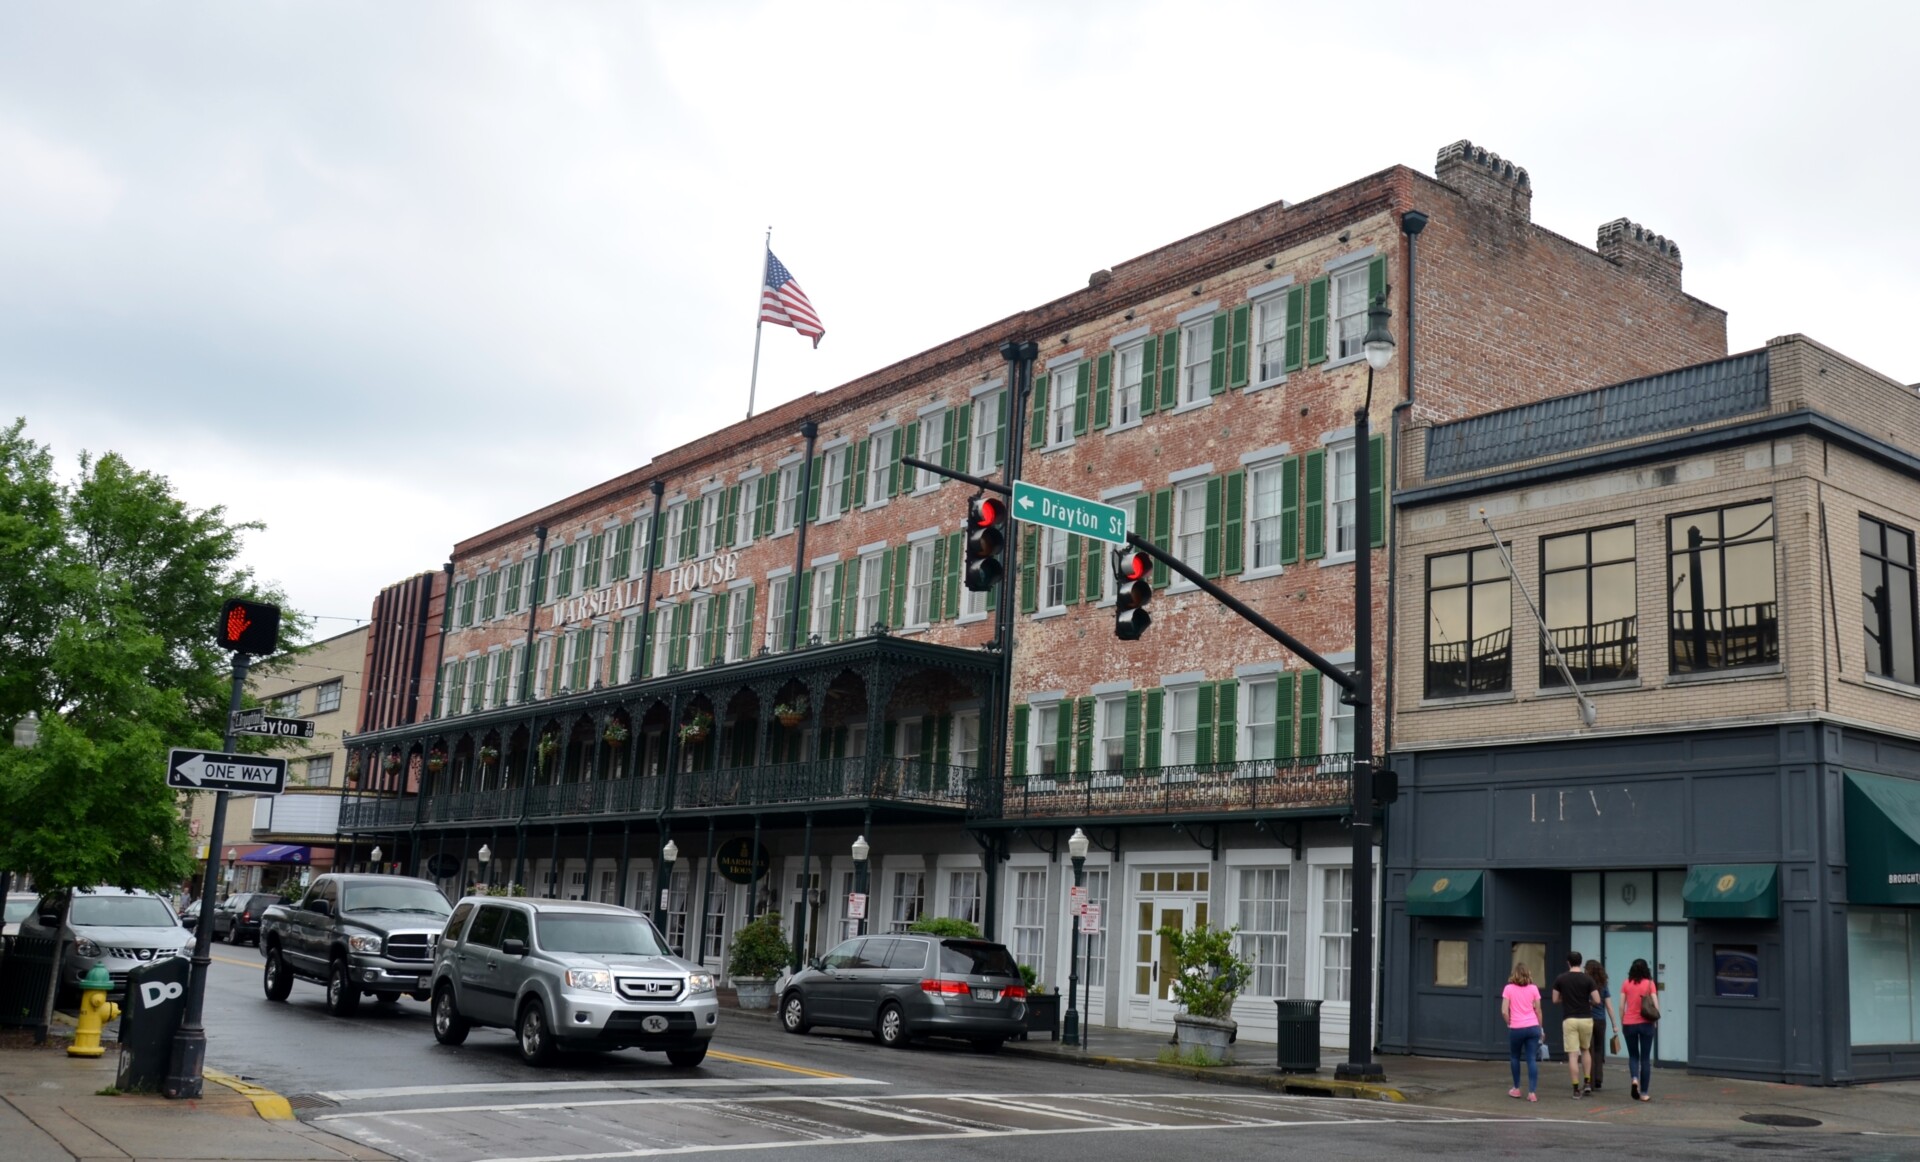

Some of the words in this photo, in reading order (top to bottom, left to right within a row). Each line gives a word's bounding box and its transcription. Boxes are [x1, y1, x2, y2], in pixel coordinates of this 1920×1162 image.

[1042, 498, 1098, 530] Drayton
[1109, 516, 1122, 536] St
[552, 579, 645, 627] MARSHALL
[668, 552, 739, 596] HOUSE
[246, 720, 298, 735] ayton
[205, 764, 236, 779] ONE
[242, 767, 273, 782] WAY
[721, 856, 765, 867] MARSHLL
[729, 865, 754, 874] HOUS
